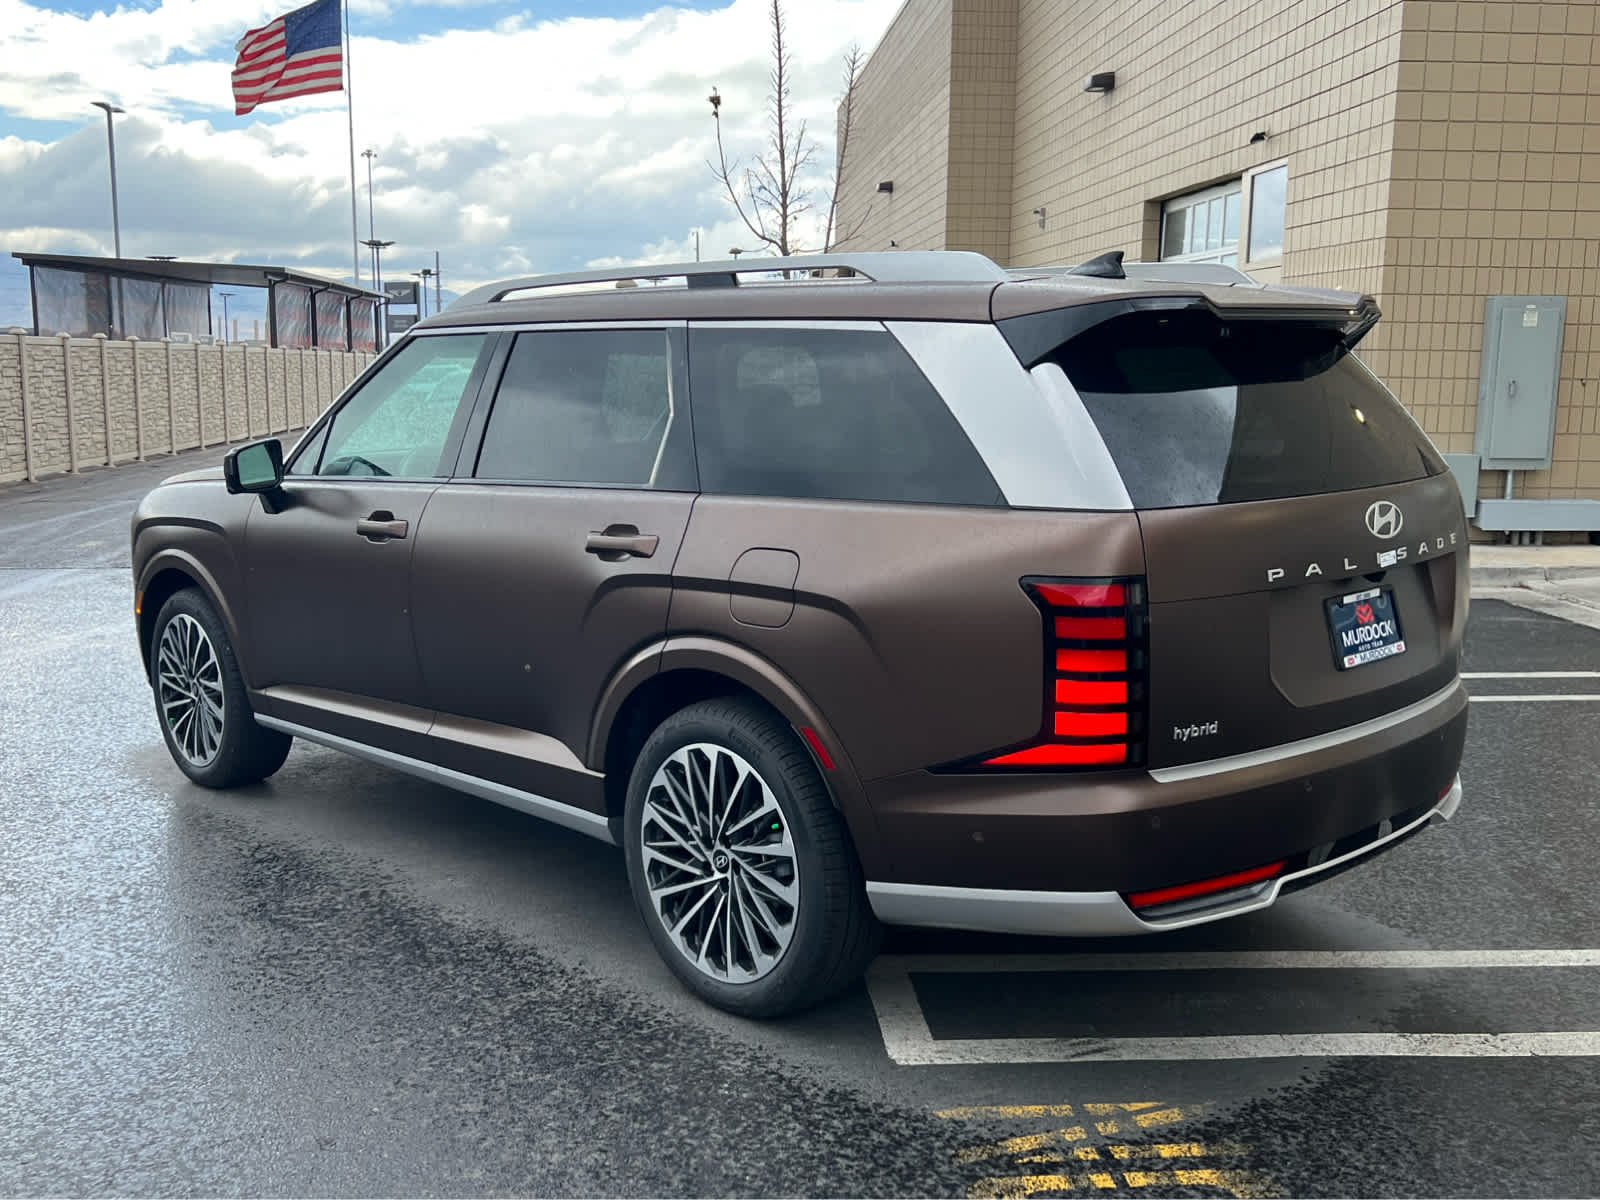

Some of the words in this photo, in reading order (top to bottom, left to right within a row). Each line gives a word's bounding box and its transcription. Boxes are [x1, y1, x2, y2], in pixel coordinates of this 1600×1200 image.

[1267, 533, 1456, 582] PALISADE
[1342, 620, 1393, 648] MURDOCK
[1173, 720, 1218, 741] hybrid
